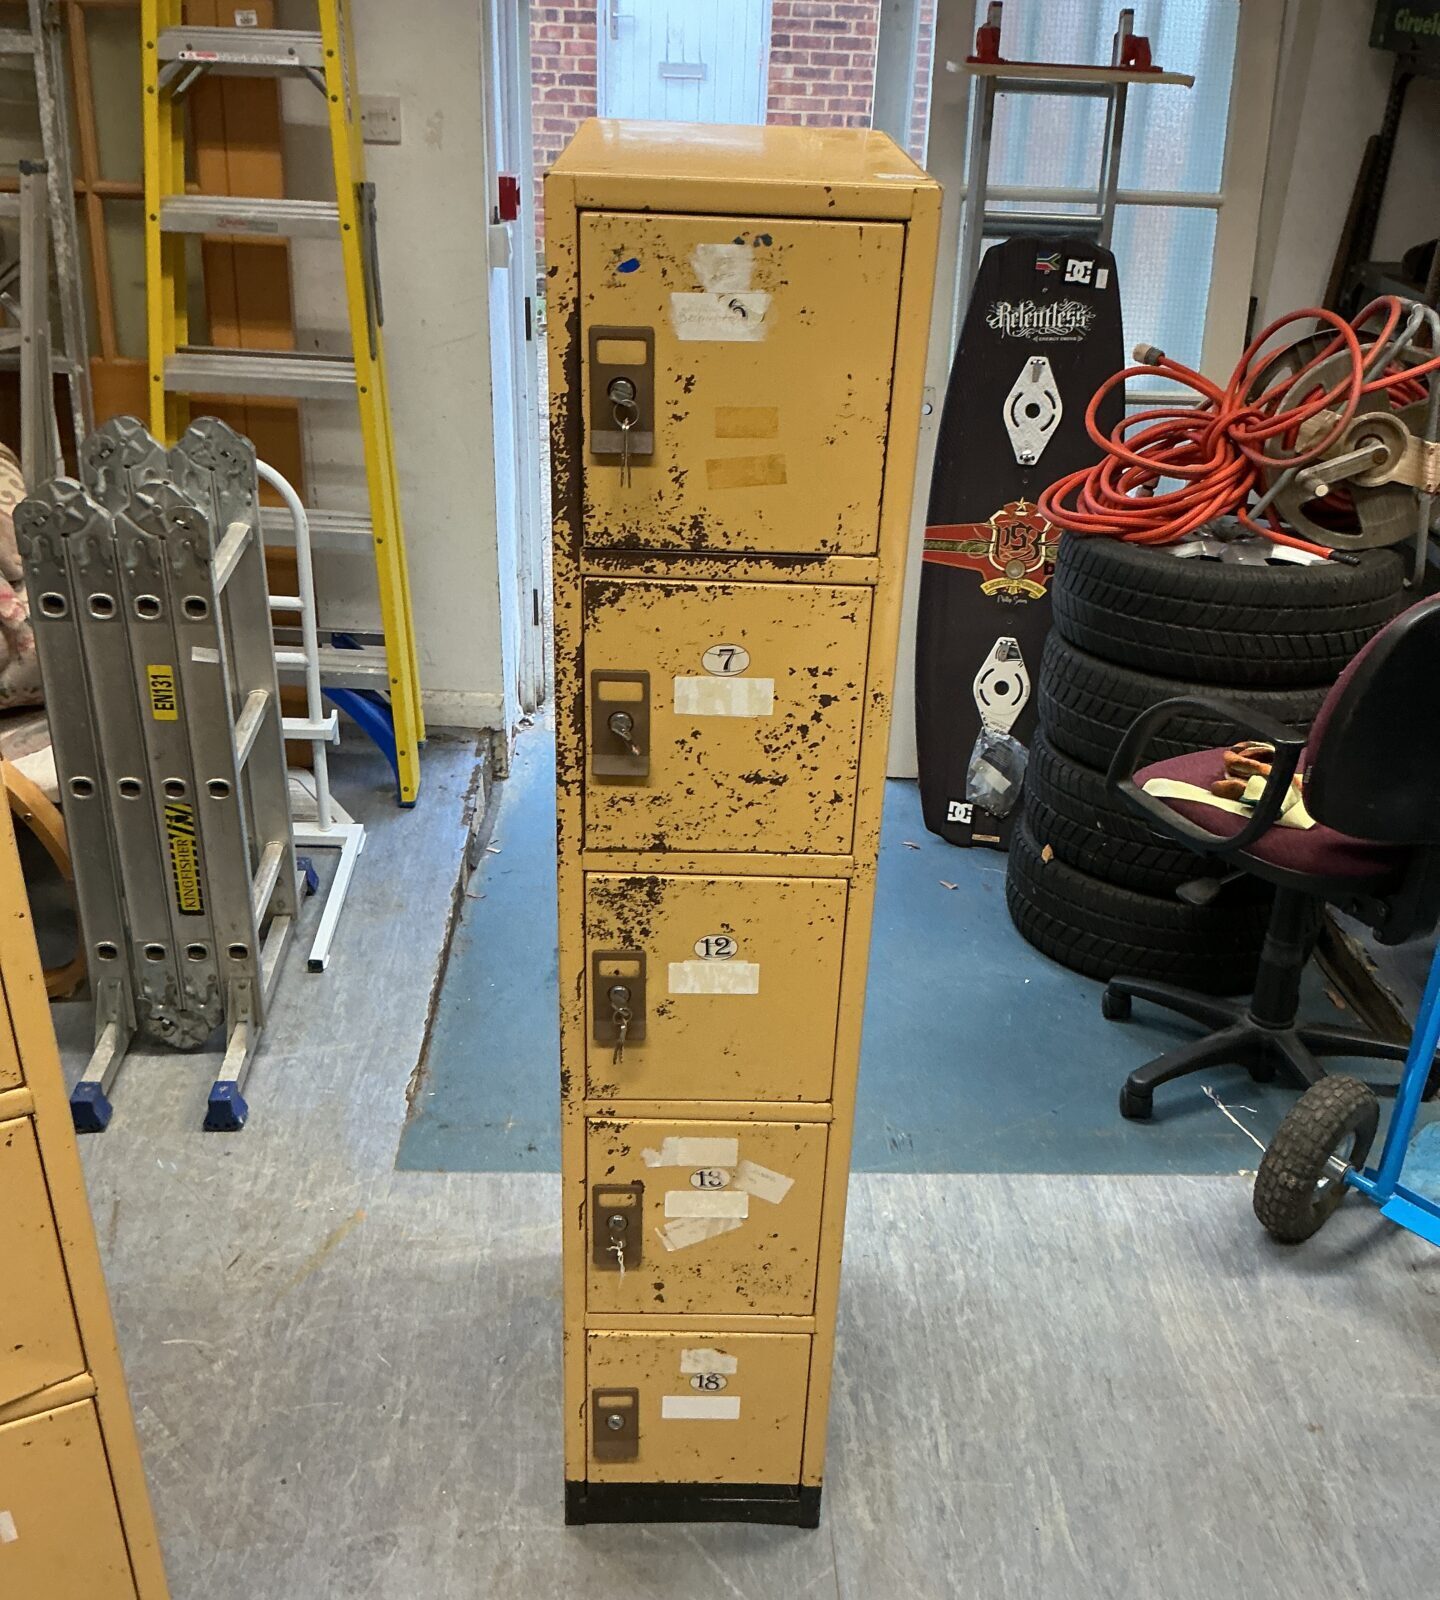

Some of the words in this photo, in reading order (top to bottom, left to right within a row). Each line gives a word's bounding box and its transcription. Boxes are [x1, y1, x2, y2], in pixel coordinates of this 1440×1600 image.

[1064, 258, 1094, 284] DC
[993, 300, 1090, 334] Relentless
[718, 648, 736, 672] 7
[150, 673, 175, 711] EN131
[946, 800, 974, 824] DC
[176, 838, 198, 908] KINGFISHER
[700, 937, 731, 957] 12
[695, 1170, 723, 1188] 13
[696, 1373, 720, 1391] 18
